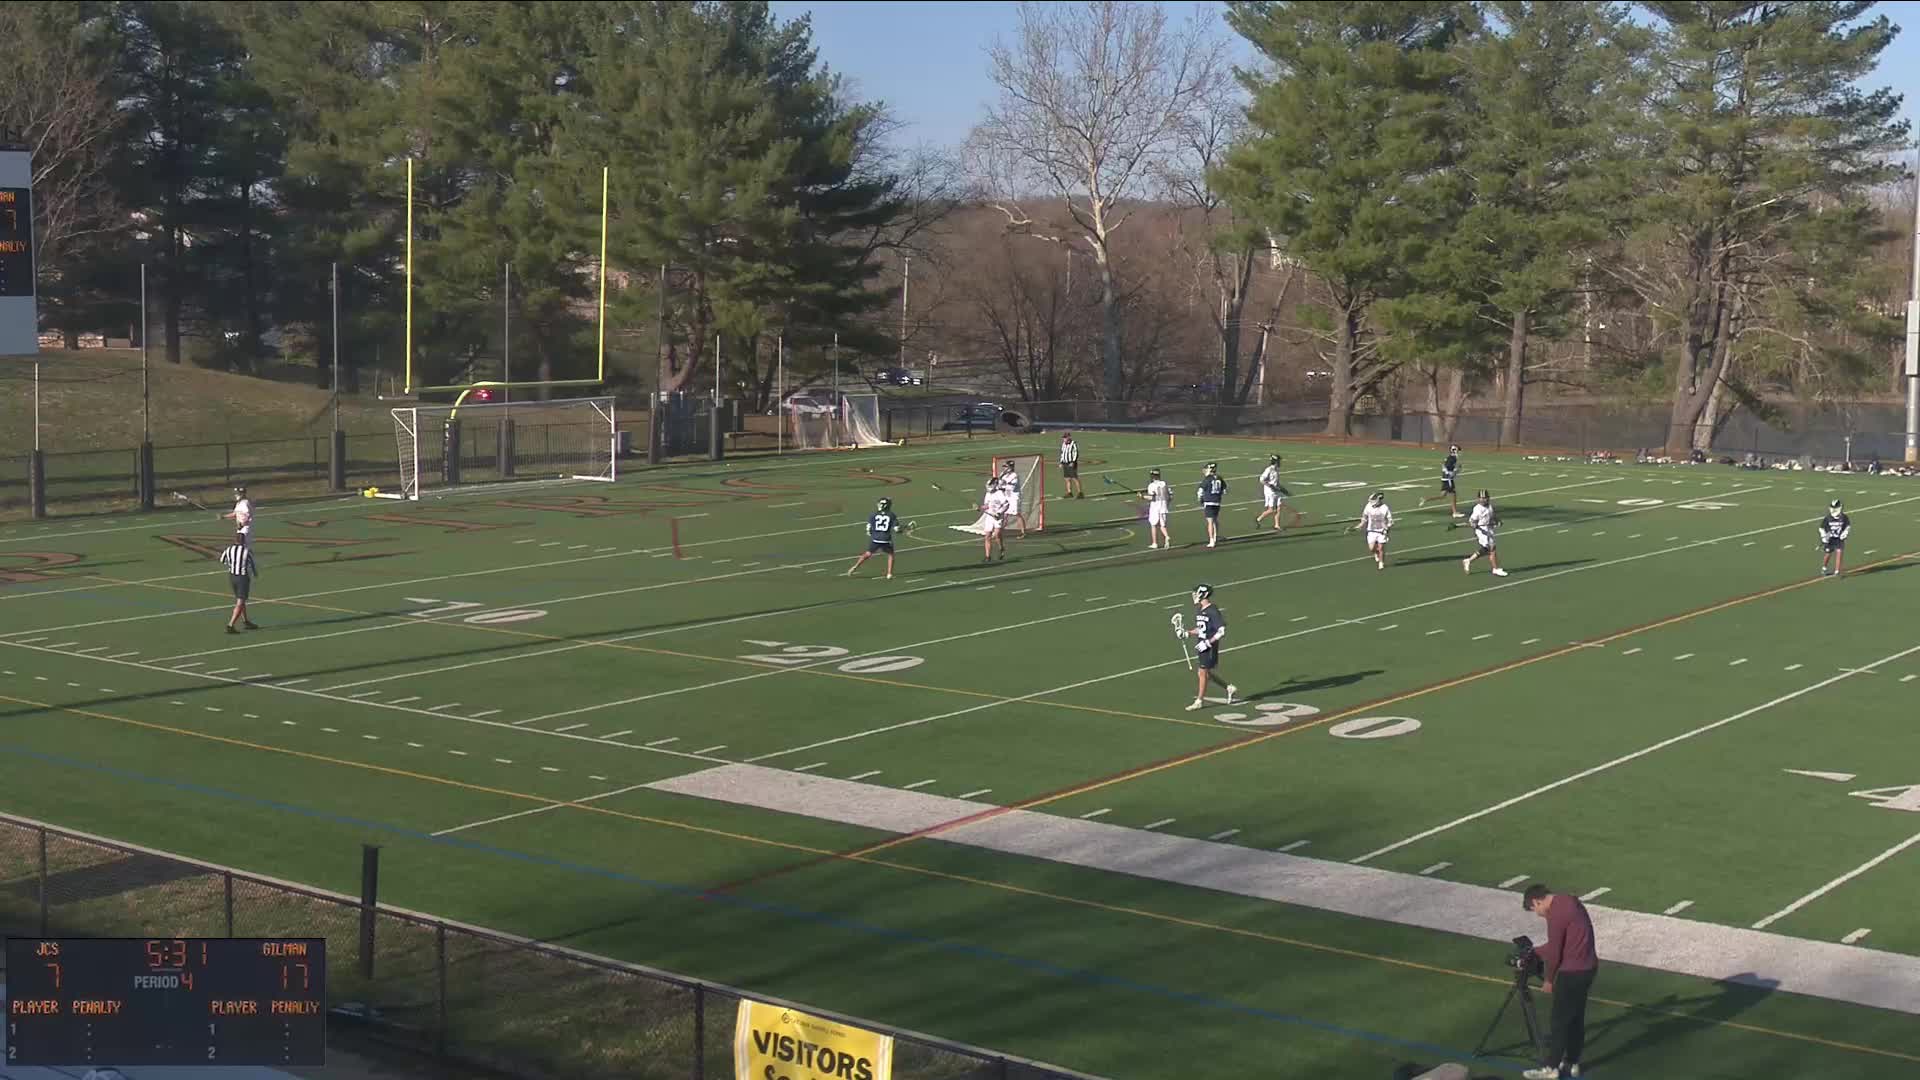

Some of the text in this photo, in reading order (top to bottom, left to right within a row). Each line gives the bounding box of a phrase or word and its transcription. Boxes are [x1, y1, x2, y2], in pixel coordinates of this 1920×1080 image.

[874, 514, 890, 531] 23
[737, 644, 926, 673] 20
[1214, 702, 1422, 739] 30
[752, 1029, 873, 1080] VISITORS
